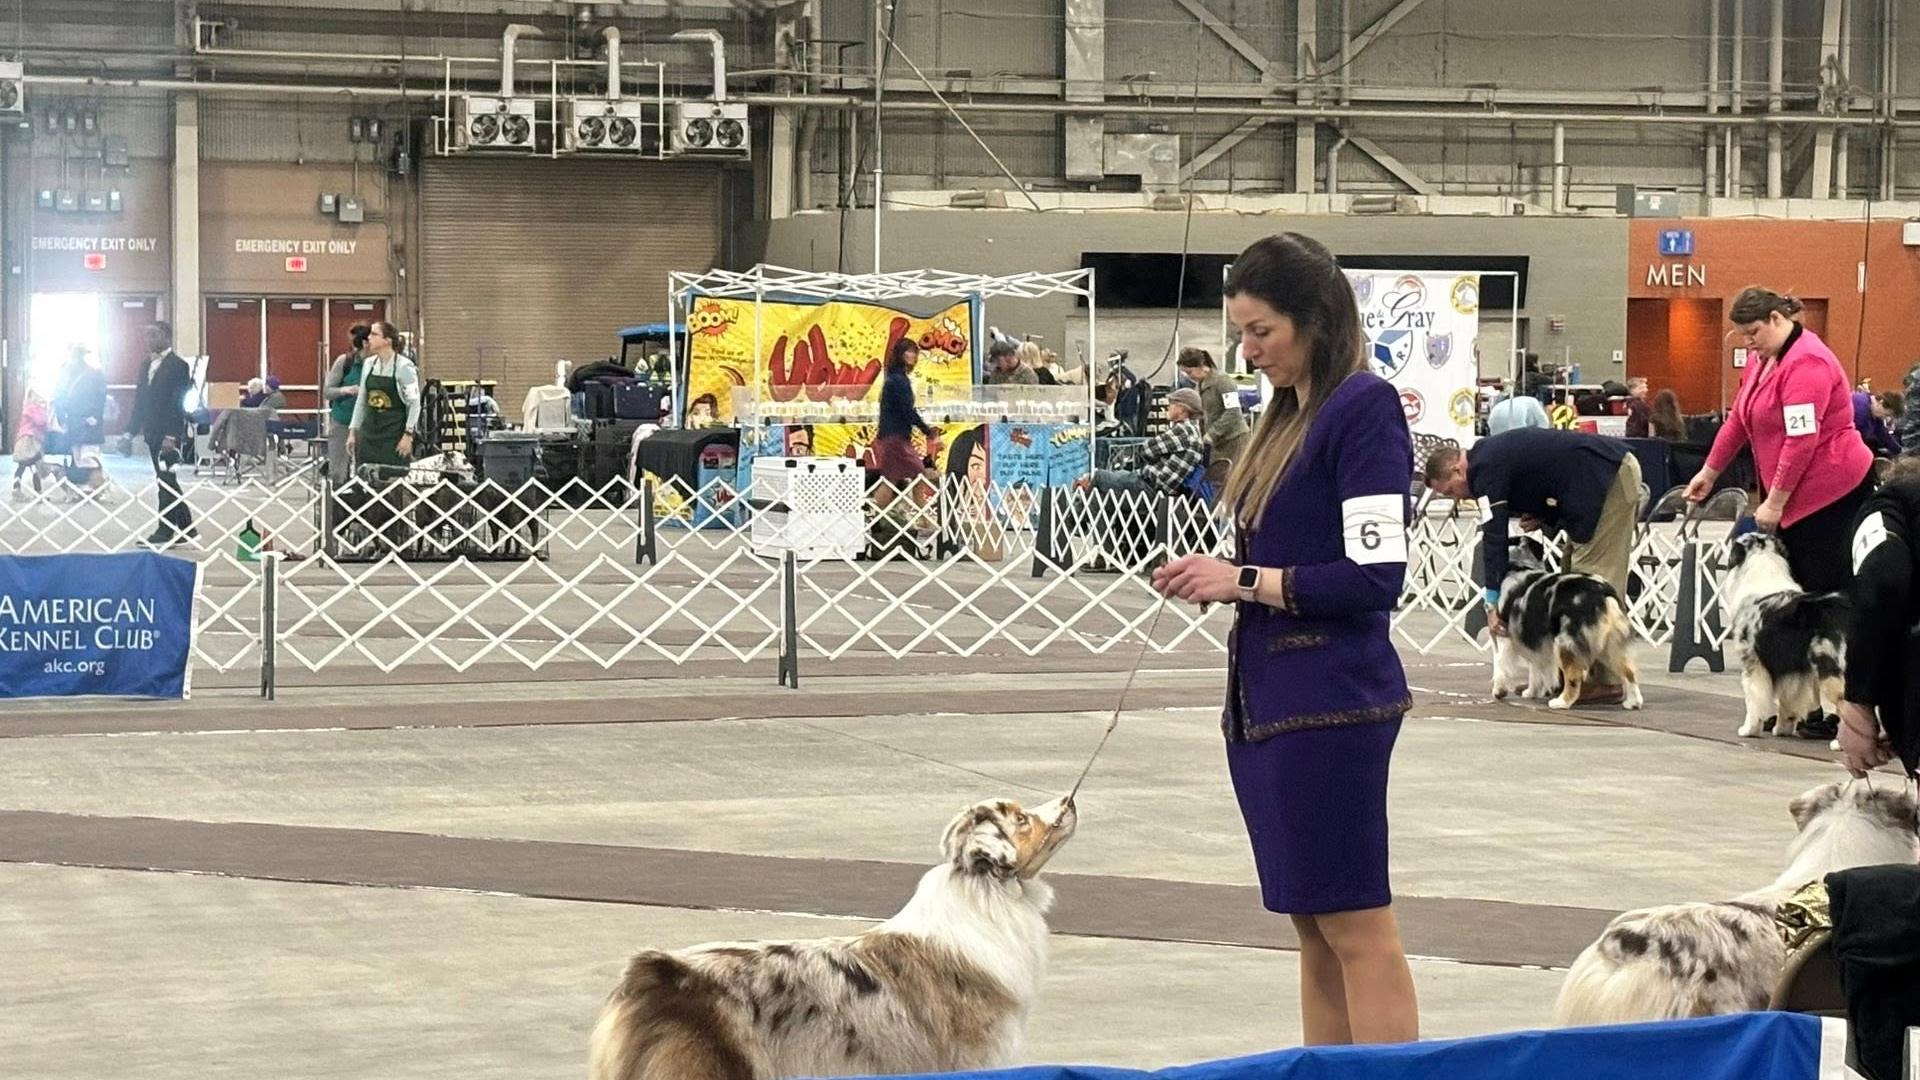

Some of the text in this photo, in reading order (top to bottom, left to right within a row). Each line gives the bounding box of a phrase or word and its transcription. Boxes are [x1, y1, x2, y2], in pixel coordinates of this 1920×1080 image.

[32, 236, 156, 251] EMERGENCY EXIT ONLY
[235, 239, 357, 254] EMERGENCY EXIT ONLY
[1646, 263, 1706, 286] MEN
[1380, 291, 1436, 337] Gray
[1789, 414, 1806, 430] 21
[1360, 519, 1381, 550] 6
[0, 595, 155, 624] AMERICAN
[44, 658, 105, 675] akc.org
